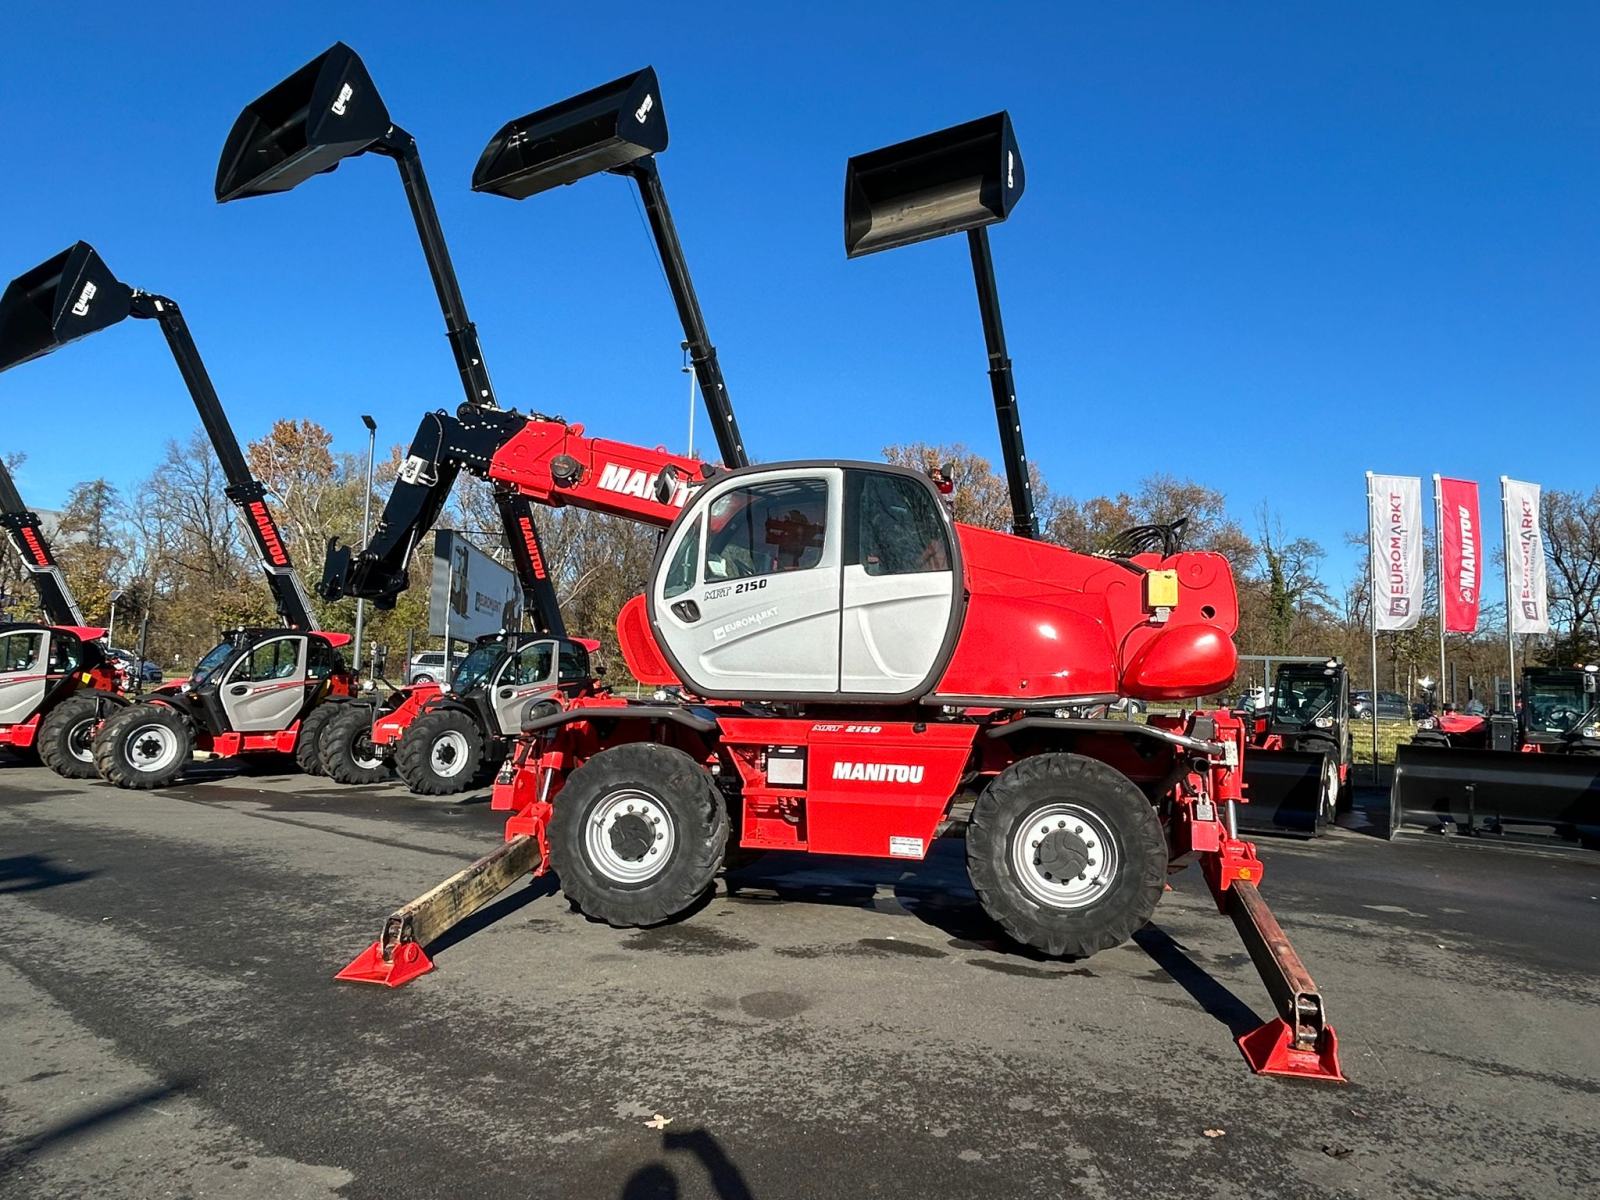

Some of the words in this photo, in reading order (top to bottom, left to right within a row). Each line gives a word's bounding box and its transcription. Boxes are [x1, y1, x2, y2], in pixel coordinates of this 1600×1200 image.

[596, 462, 704, 508] MANT
[21, 527, 49, 566] MANITOU
[249, 501, 288, 565] MANITOU
[519, 517, 546, 579] MANITOU
[1390, 492, 1406, 594] EUROMARKT
[1458, 504, 1475, 589] MANITOU
[704, 586, 732, 601] MRT
[735, 579, 767, 594] 2150
[724, 606, 779, 633] EUROMARKT
[845, 725, 882, 733] 2150
[832, 762, 925, 784] MANITOU
